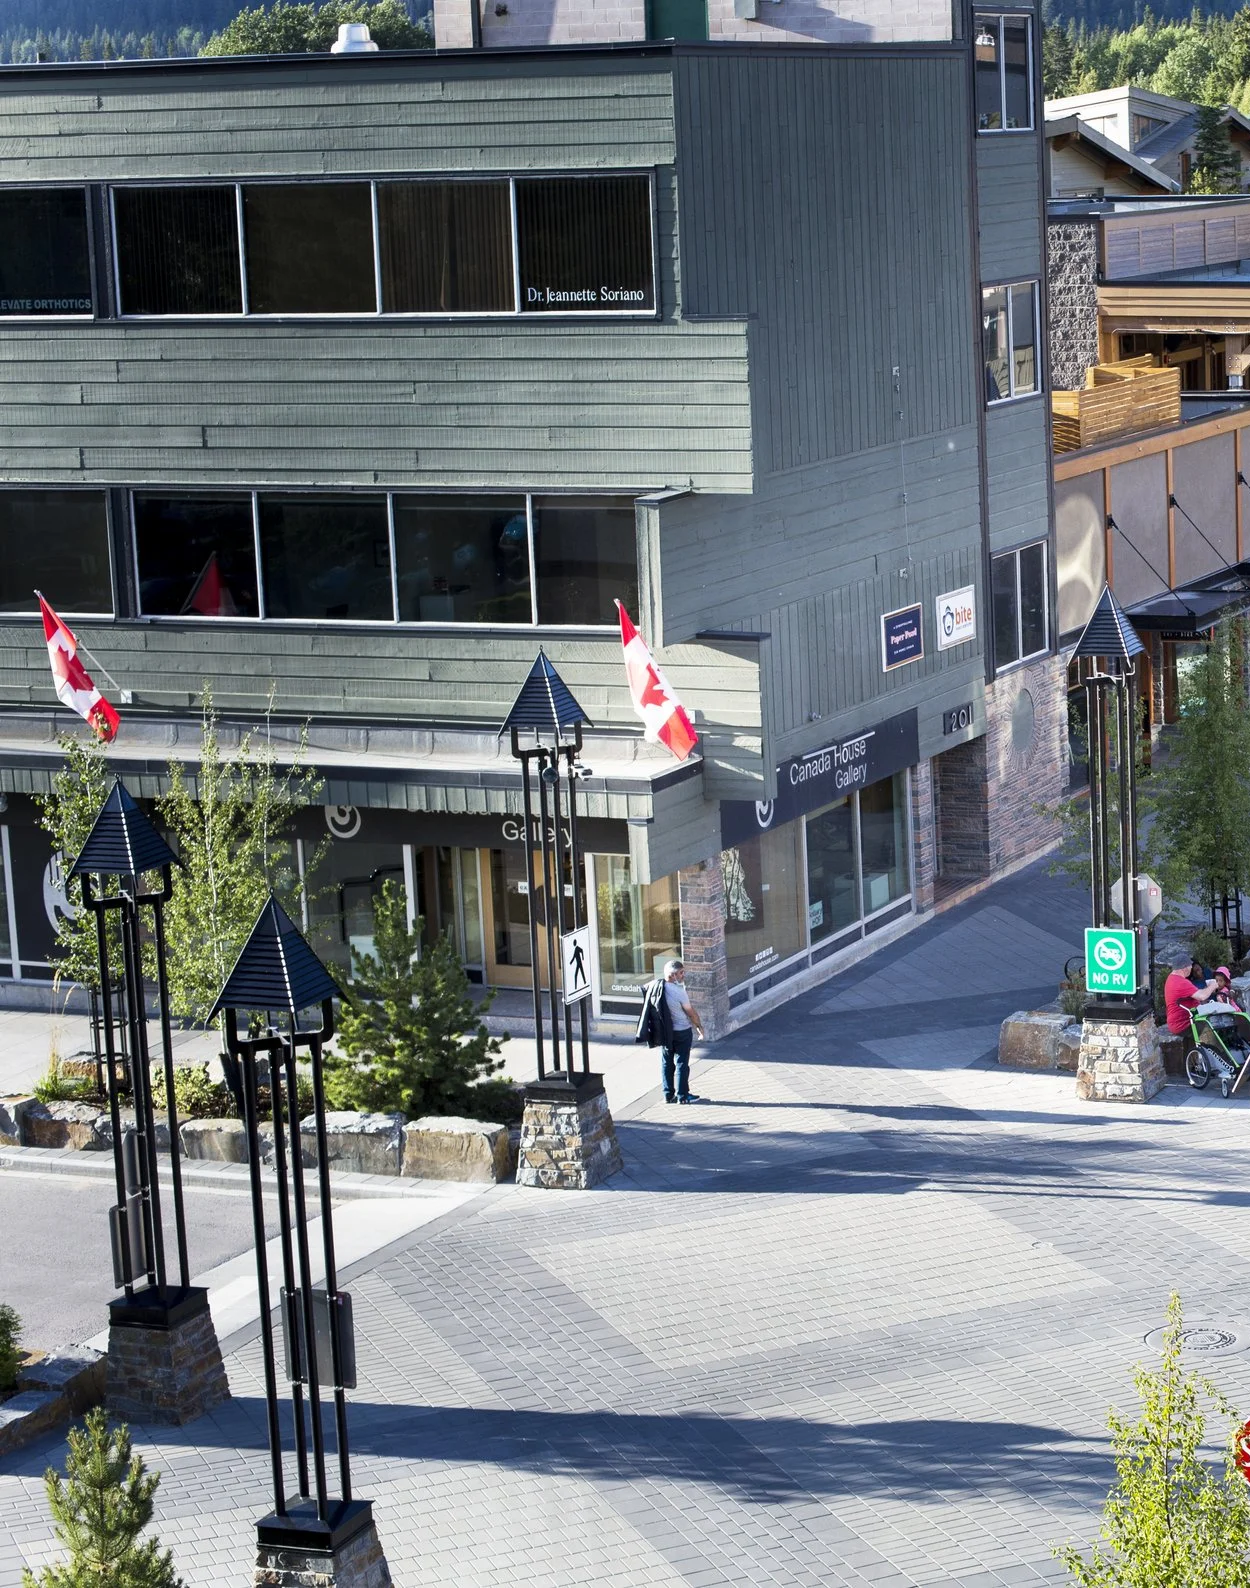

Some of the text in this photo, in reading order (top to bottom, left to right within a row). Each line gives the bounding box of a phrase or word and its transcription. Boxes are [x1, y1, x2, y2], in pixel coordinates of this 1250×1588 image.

[0, 298, 92, 310] EVATE ORTHOTICS
[527, 286, 645, 304] Dr. Jeannette Soriano
[955, 606, 972, 624] bite
[951, 708, 974, 732] 201
[789, 738, 867, 786] Canada House
[835, 762, 868, 790] Gallery
[1092, 972, 1129, 986] NO RV
